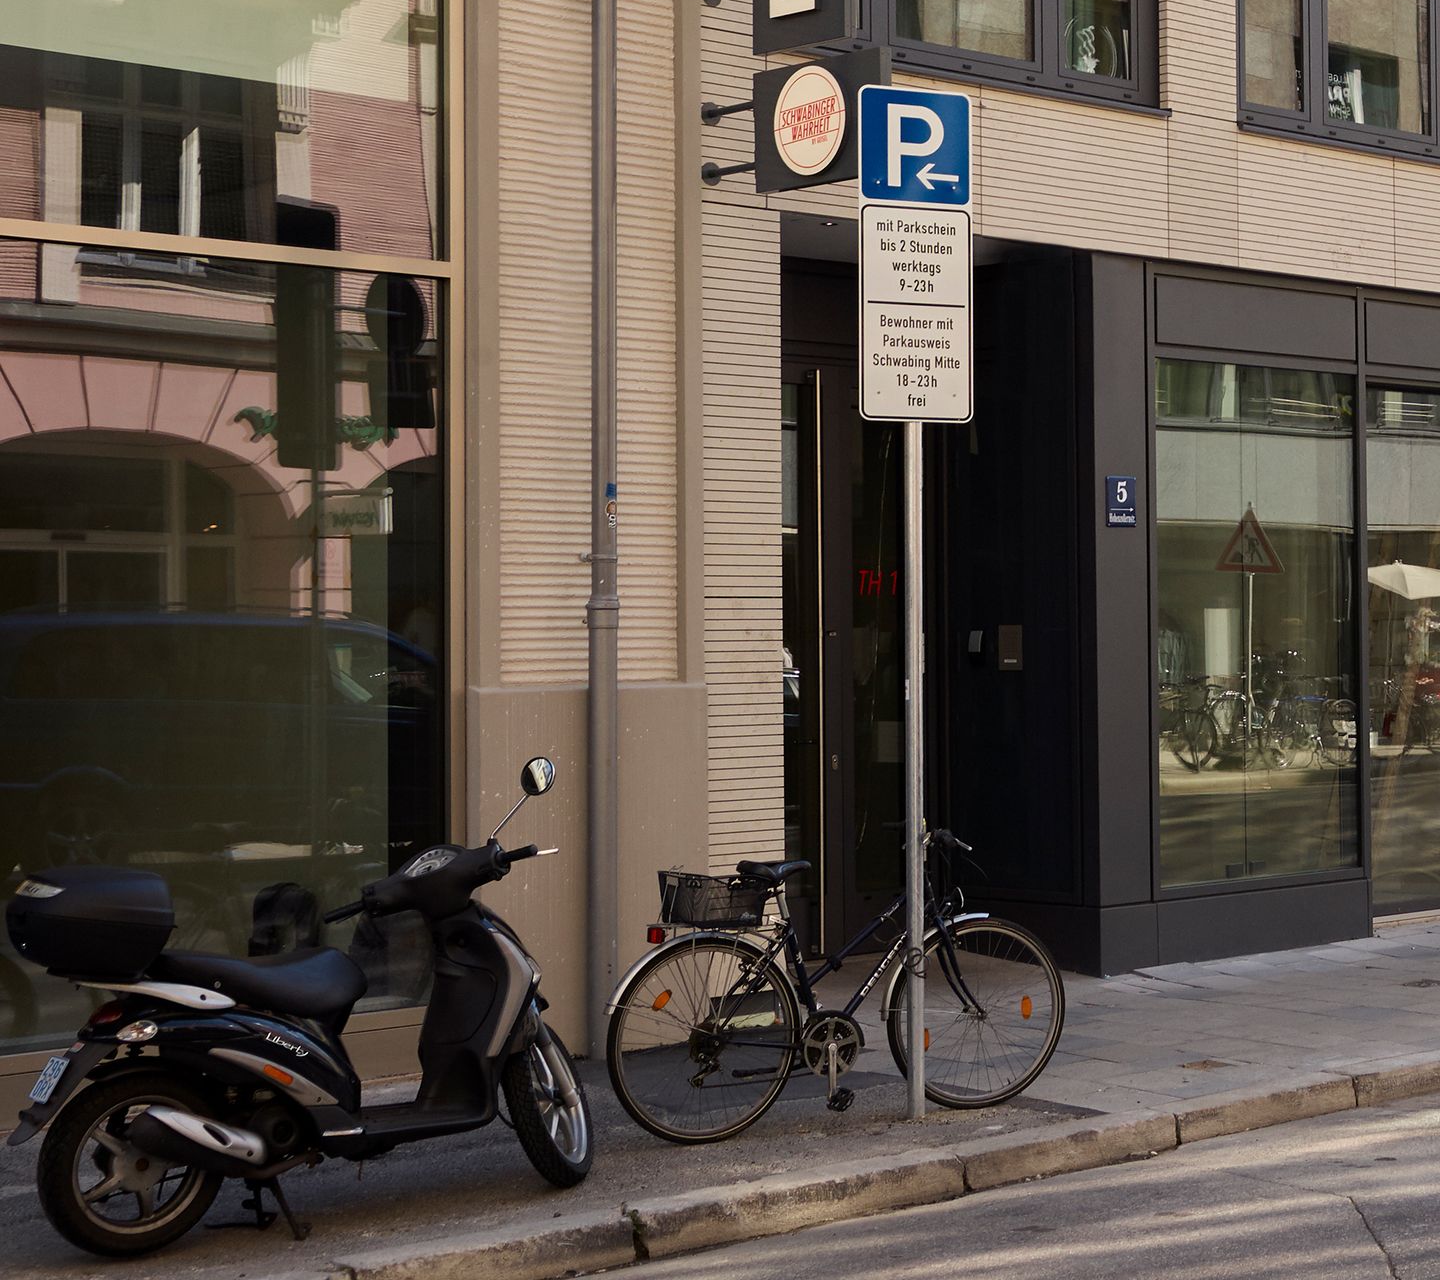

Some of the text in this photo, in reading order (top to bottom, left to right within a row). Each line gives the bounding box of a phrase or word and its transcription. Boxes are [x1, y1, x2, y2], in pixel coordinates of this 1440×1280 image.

[782, 97, 836, 127] SCHWABINGER
[791, 116, 830, 141] WAHRHEIT
[887, 103, 945, 187] P
[876, 219, 956, 236] mit Parkschein
[880, 239, 953, 255] bis 2 Stunden
[892, 260, 941, 276] werktags
[880, 314, 954, 330] Bewohner mit
[883, 334, 951, 349] Parkausweis
[872, 353, 960, 371] Schwabing Mitte
[907, 393, 926, 407] frei
[1116, 480, 1128, 503] 5
[265, 1032, 310, 1057] Liberty
